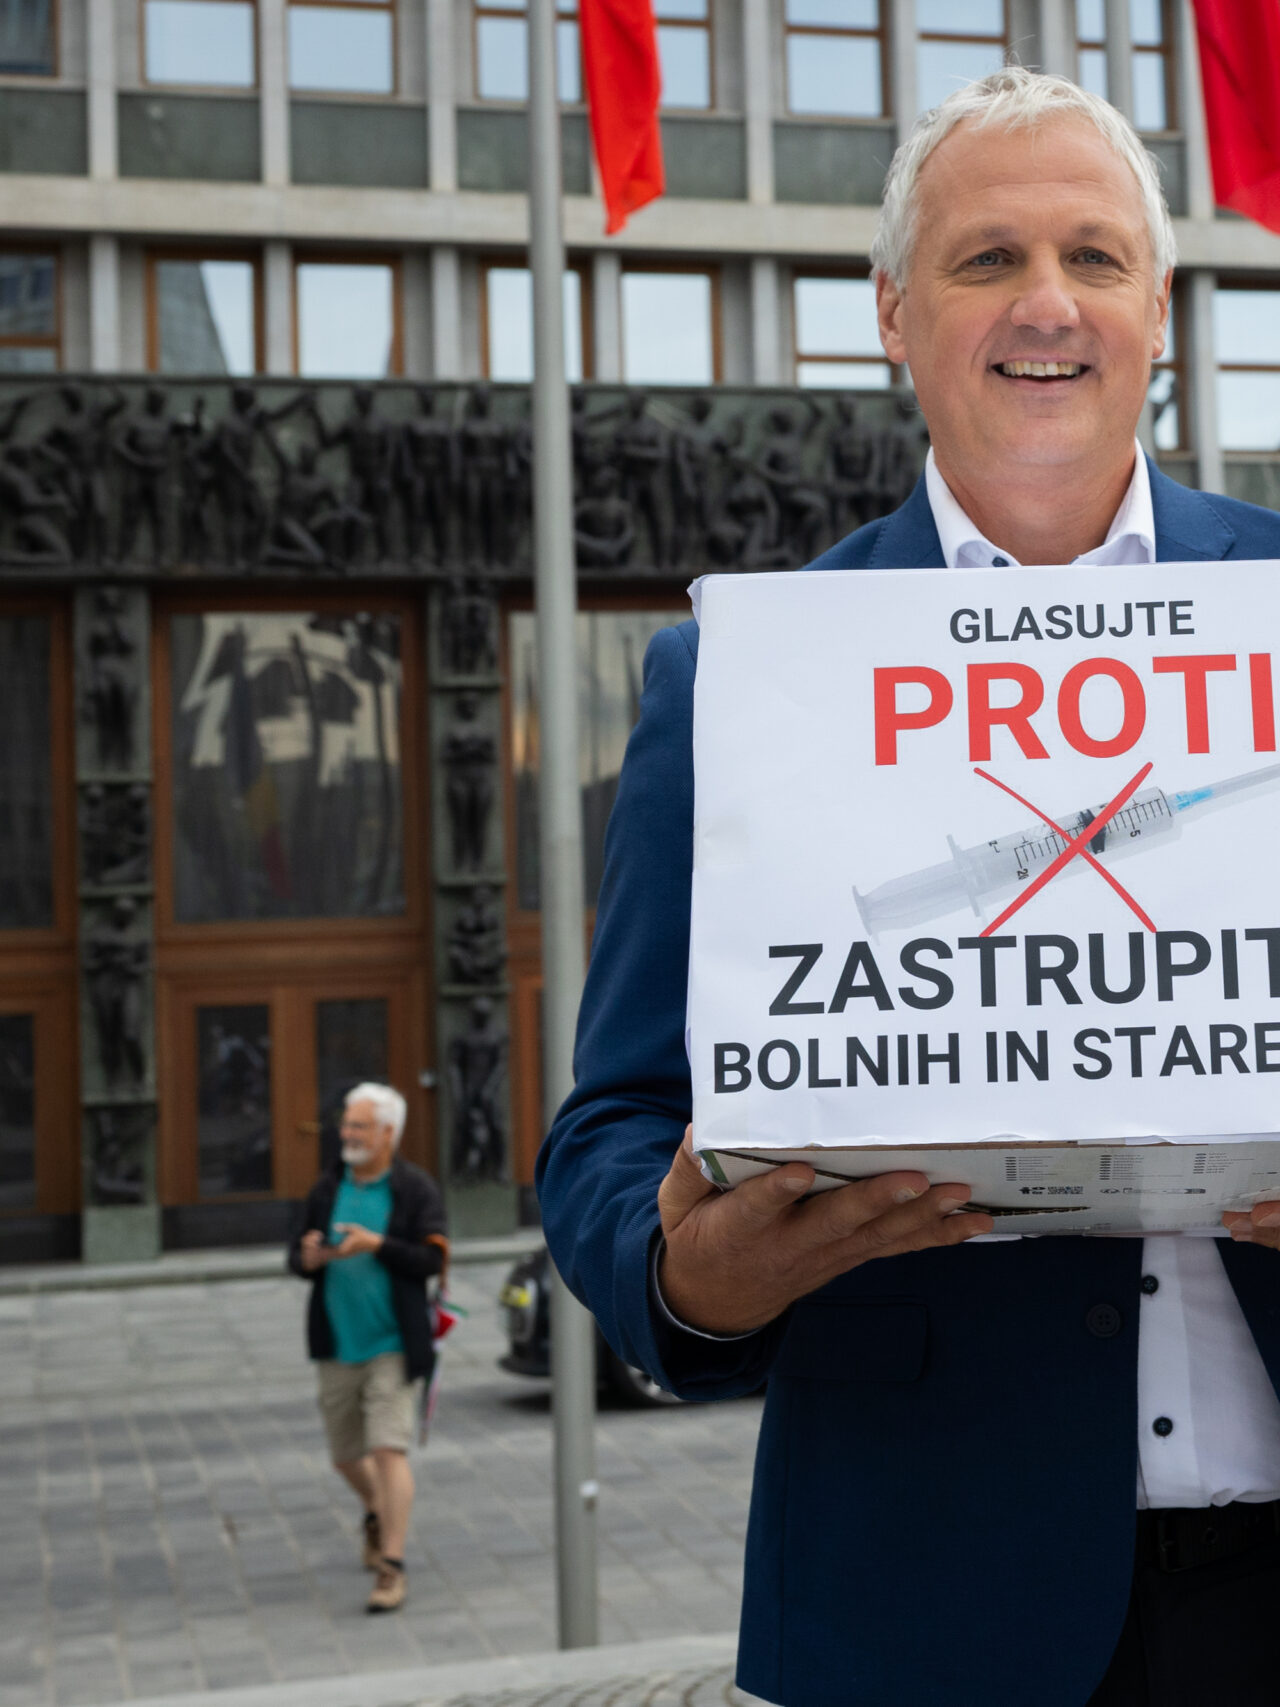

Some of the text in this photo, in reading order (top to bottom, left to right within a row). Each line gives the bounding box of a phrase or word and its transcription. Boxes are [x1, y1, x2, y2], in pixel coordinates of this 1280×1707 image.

[949, 601, 1195, 643] GLASUJTE
[873, 653, 1276, 766] PROTI
[713, 1033, 960, 1094] BOLNIH
[986, 1030, 1050, 1083] IN
